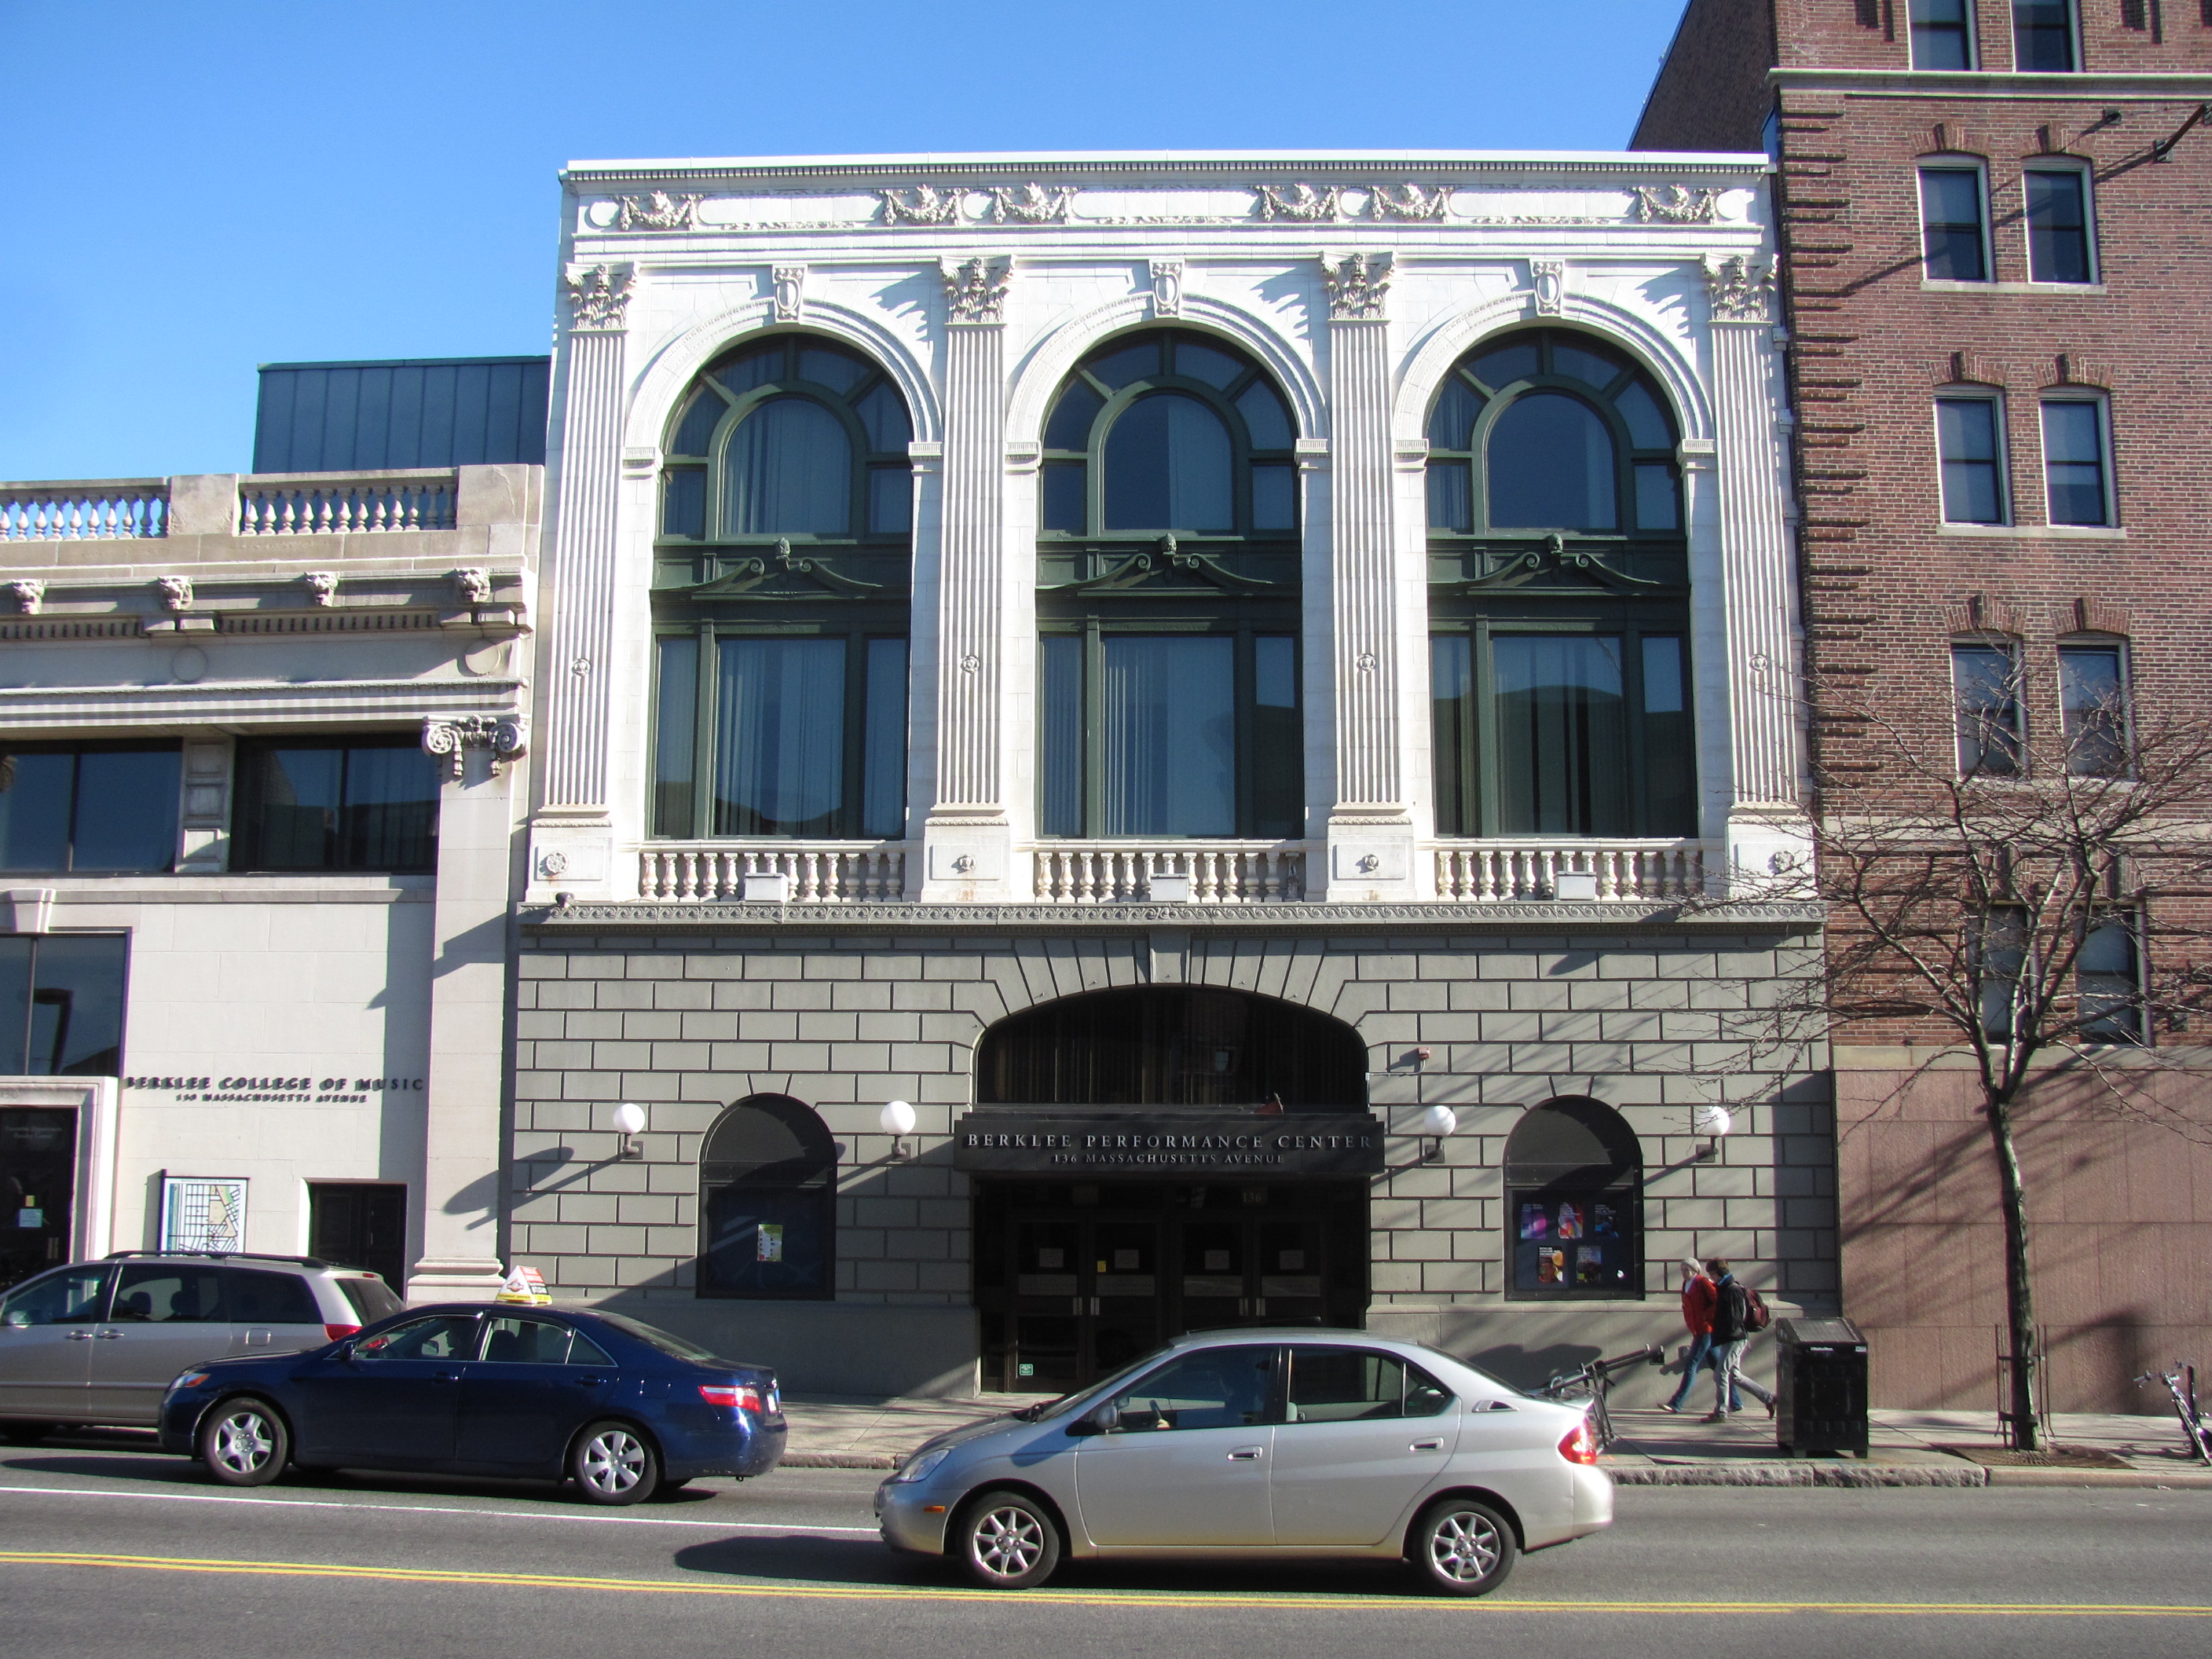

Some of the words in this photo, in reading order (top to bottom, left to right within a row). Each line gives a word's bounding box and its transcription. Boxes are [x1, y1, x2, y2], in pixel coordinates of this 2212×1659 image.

[126, 1077, 211, 1090] BERKLEE
[219, 1077, 311, 1090] COLLEGE
[320, 1079, 346, 1090] OF
[355, 1079, 423, 1091] MUSIC
[202, 1093, 311, 1102] MASSACHUSETTS
[315, 1094, 368, 1103] AVENUE
[968, 1133, 1071, 1148] BERKLEE
[1086, 1135, 1262, 1148] PERFORMANCE
[1277, 1135, 1372, 1148] CENTER
[1053, 1154, 1077, 1163] 136
[1086, 1154, 1217, 1163] MASSACHUSETTS
[1224, 1155, 1284, 1163] AVENUE
[1242, 1192, 1262, 1203] 136
